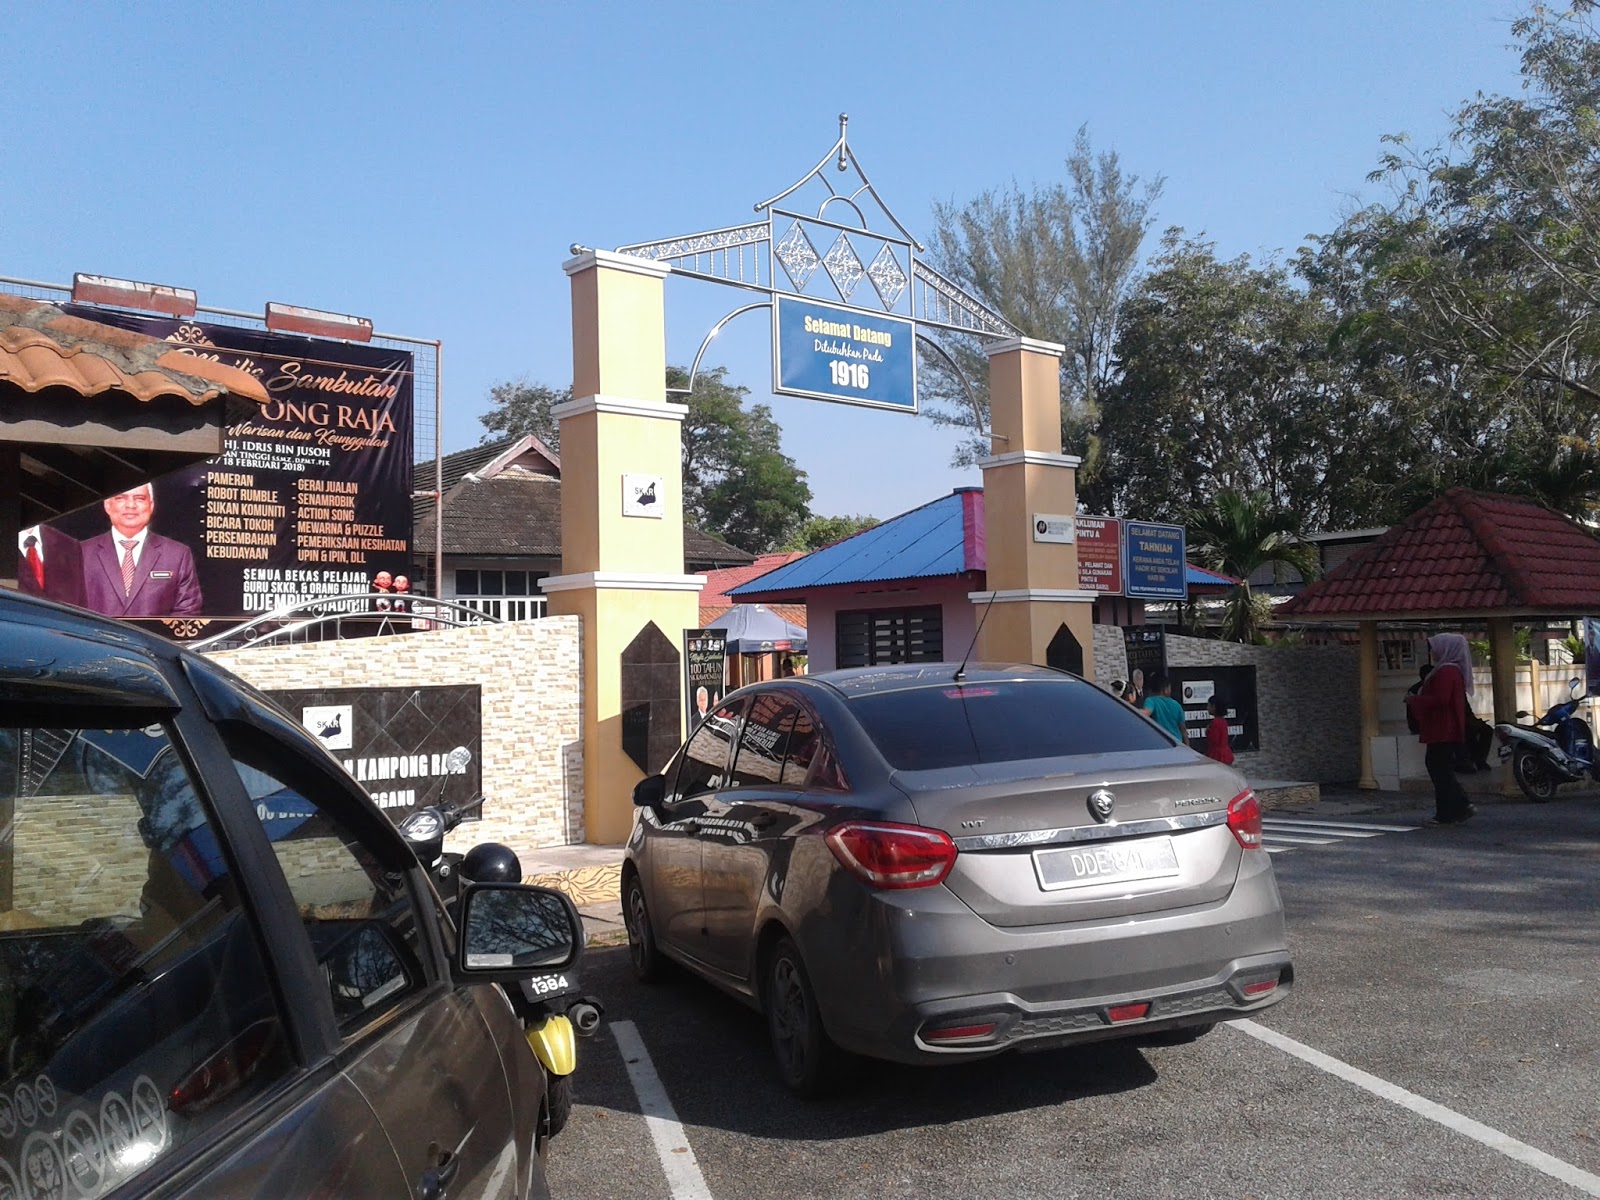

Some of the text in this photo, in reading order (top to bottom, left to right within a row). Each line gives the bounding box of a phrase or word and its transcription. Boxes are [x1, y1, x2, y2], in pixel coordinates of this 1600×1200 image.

[804, 315, 892, 347] Selamat Datang
[814, 338, 884, 363] Ditubuhkan Pada
[266, 362, 398, 399] Sambutan
[829, 359, 869, 389] 1916
[260, 398, 397, 436] ONG RAJA
[225, 421, 389, 451] Warisan dan Keunggulan
[223, 450, 238, 458] AN
[239, 451, 270, 461] TINGGI
[242, 441, 272, 453] IDRIS
[275, 444, 294, 455] BIN
[297, 446, 331, 458] JUSOH
[223, 457, 234, 466] 18
[236, 458, 280, 470] FEBRUARI
[282, 462, 305, 472] 2018)
[207, 472, 254, 487] PAMERAN
[298, 479, 358, 494] GERAI JUALAN
[207, 486, 278, 503] ROBOT RUMBLE
[298, 493, 355, 508] SENAMROBIK
[207, 501, 285, 518] SUKAN KOMUNITI
[298, 507, 354, 521] ACTION SONG
[206, 516, 274, 532] BICARA TOKOH
[298, 521, 384, 537] MEWARNA & PUZZLE
[1076, 519, 1105, 529] AKLUMAN
[206, 530, 277, 546] PERSEMBAHAN
[1131, 527, 1180, 539] SELAMAT DATANG
[298, 535, 406, 552] PEMERIKSAAN KESIHATAN
[1139, 541, 1173, 553] TAHNIAH
[206, 545, 268, 560] KEBUDAYAAN
[298, 549, 366, 564] UPIN & IPIN, DLL
[243, 568, 370, 584] SEMUA BEKAS PELAJAR,
[243, 581, 370, 595] GURU SKKR, & ORANG RAMAI
[357, 754, 428, 781] KAMPONG
[1070, 850, 1111, 877] DDE
[532, 975, 568, 995] 1384
